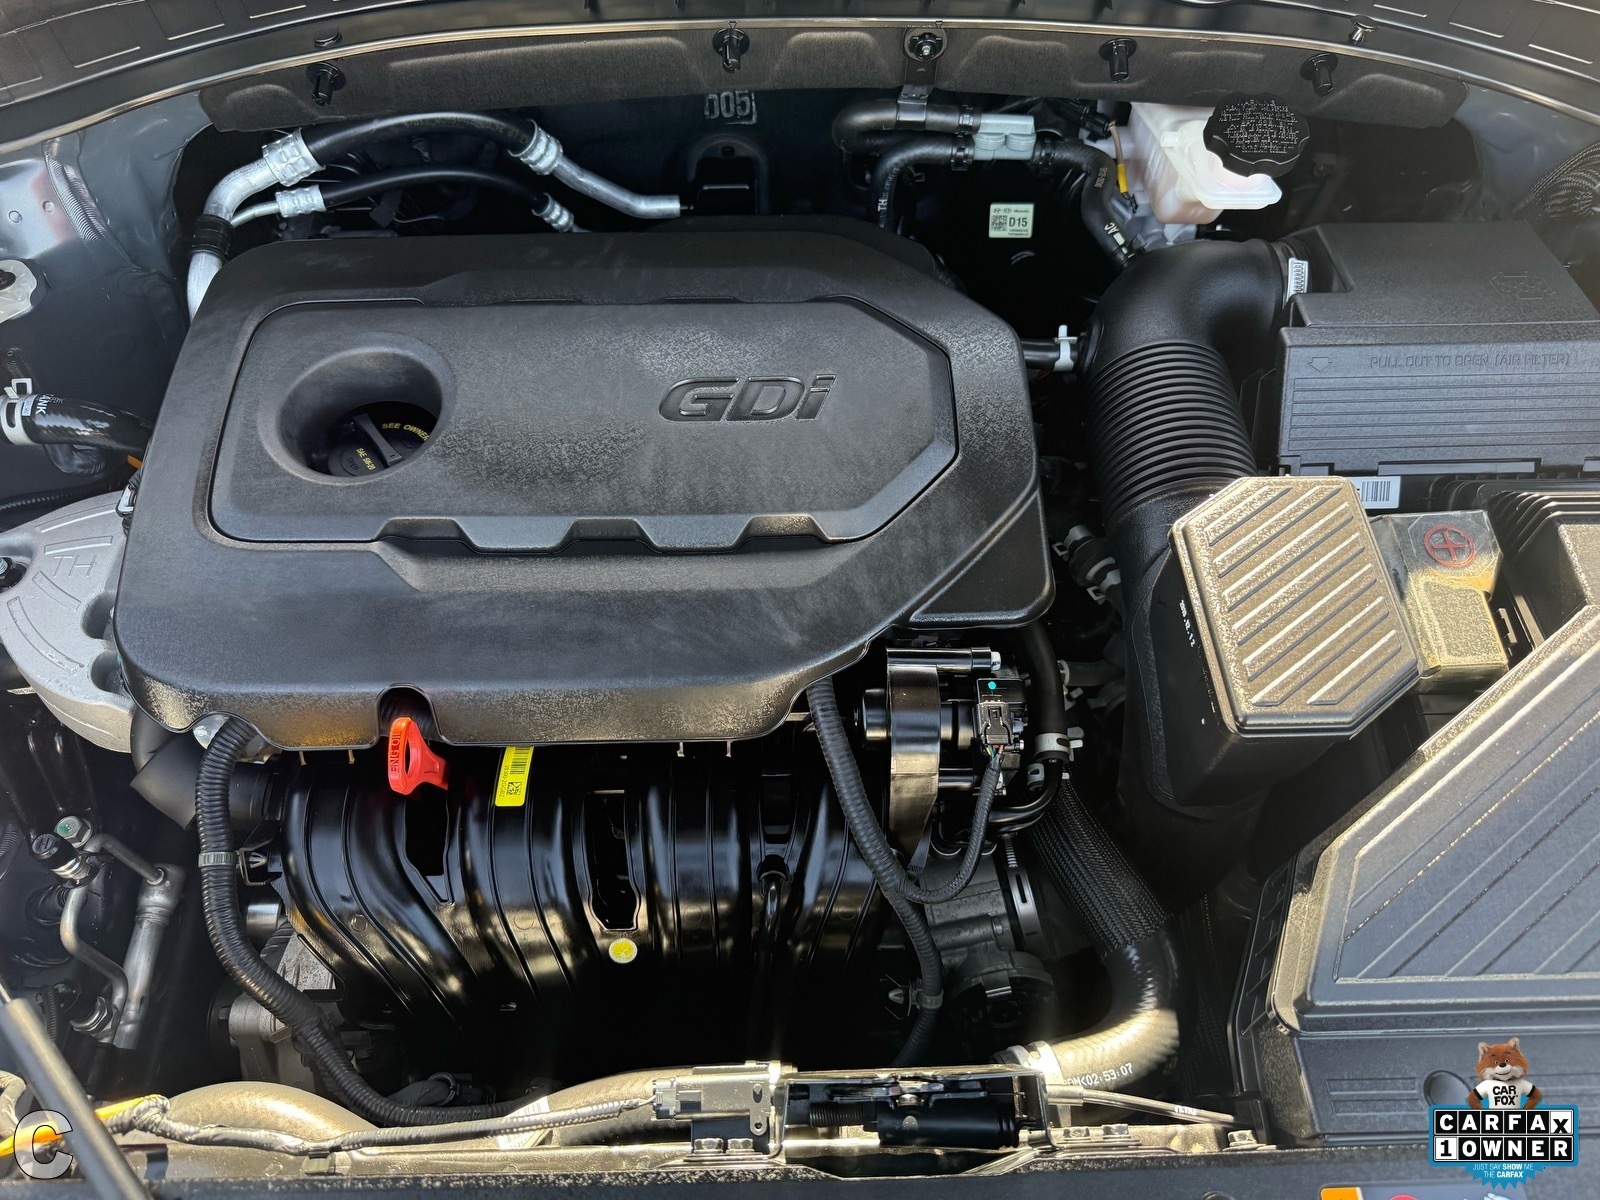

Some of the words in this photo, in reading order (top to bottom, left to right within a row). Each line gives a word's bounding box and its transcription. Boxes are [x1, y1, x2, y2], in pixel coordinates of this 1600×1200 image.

[1009, 217, 1028, 227] D15
[1370, 356, 1403, 369] PULL
[1405, 355, 1432, 368] OUT
[1435, 355, 1451, 367] TO
[1454, 354, 1489, 367] OPEN
[1495, 353, 1520, 367] (AIR
[1524, 352, 1569, 367] FILTER)
[658, 373, 837, 422] GDi
[382, 422, 401, 430] SEE
[356, 447, 367, 458] SAE
[53, 555, 98, 578] TH
[391, 731, 402, 747] OIL
[389, 750, 400, 774] ENG
